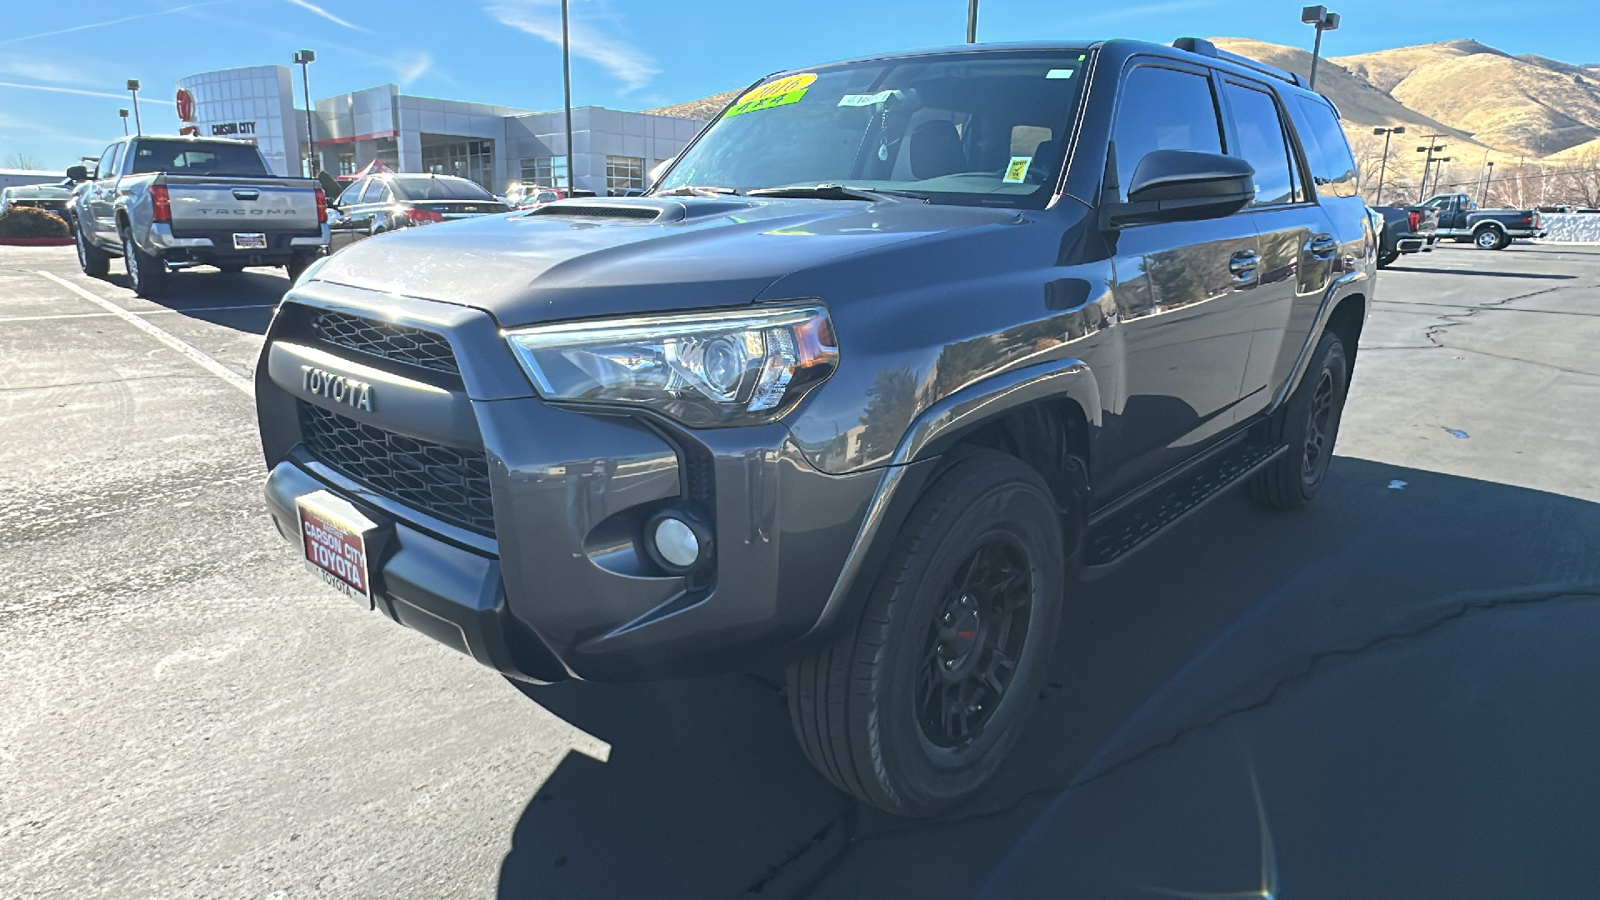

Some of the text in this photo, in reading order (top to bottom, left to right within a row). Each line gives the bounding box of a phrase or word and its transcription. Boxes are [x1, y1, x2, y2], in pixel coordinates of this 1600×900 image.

[212, 123, 238, 135] CARSON
[239, 122, 255, 133] CITY
[301, 365, 374, 413] TOYOTA
[304, 521, 342, 553] CARSON
[344, 543, 364, 567] CITY
[311, 541, 362, 588] TOYOTA
[321, 569, 352, 598] TOYOTA
